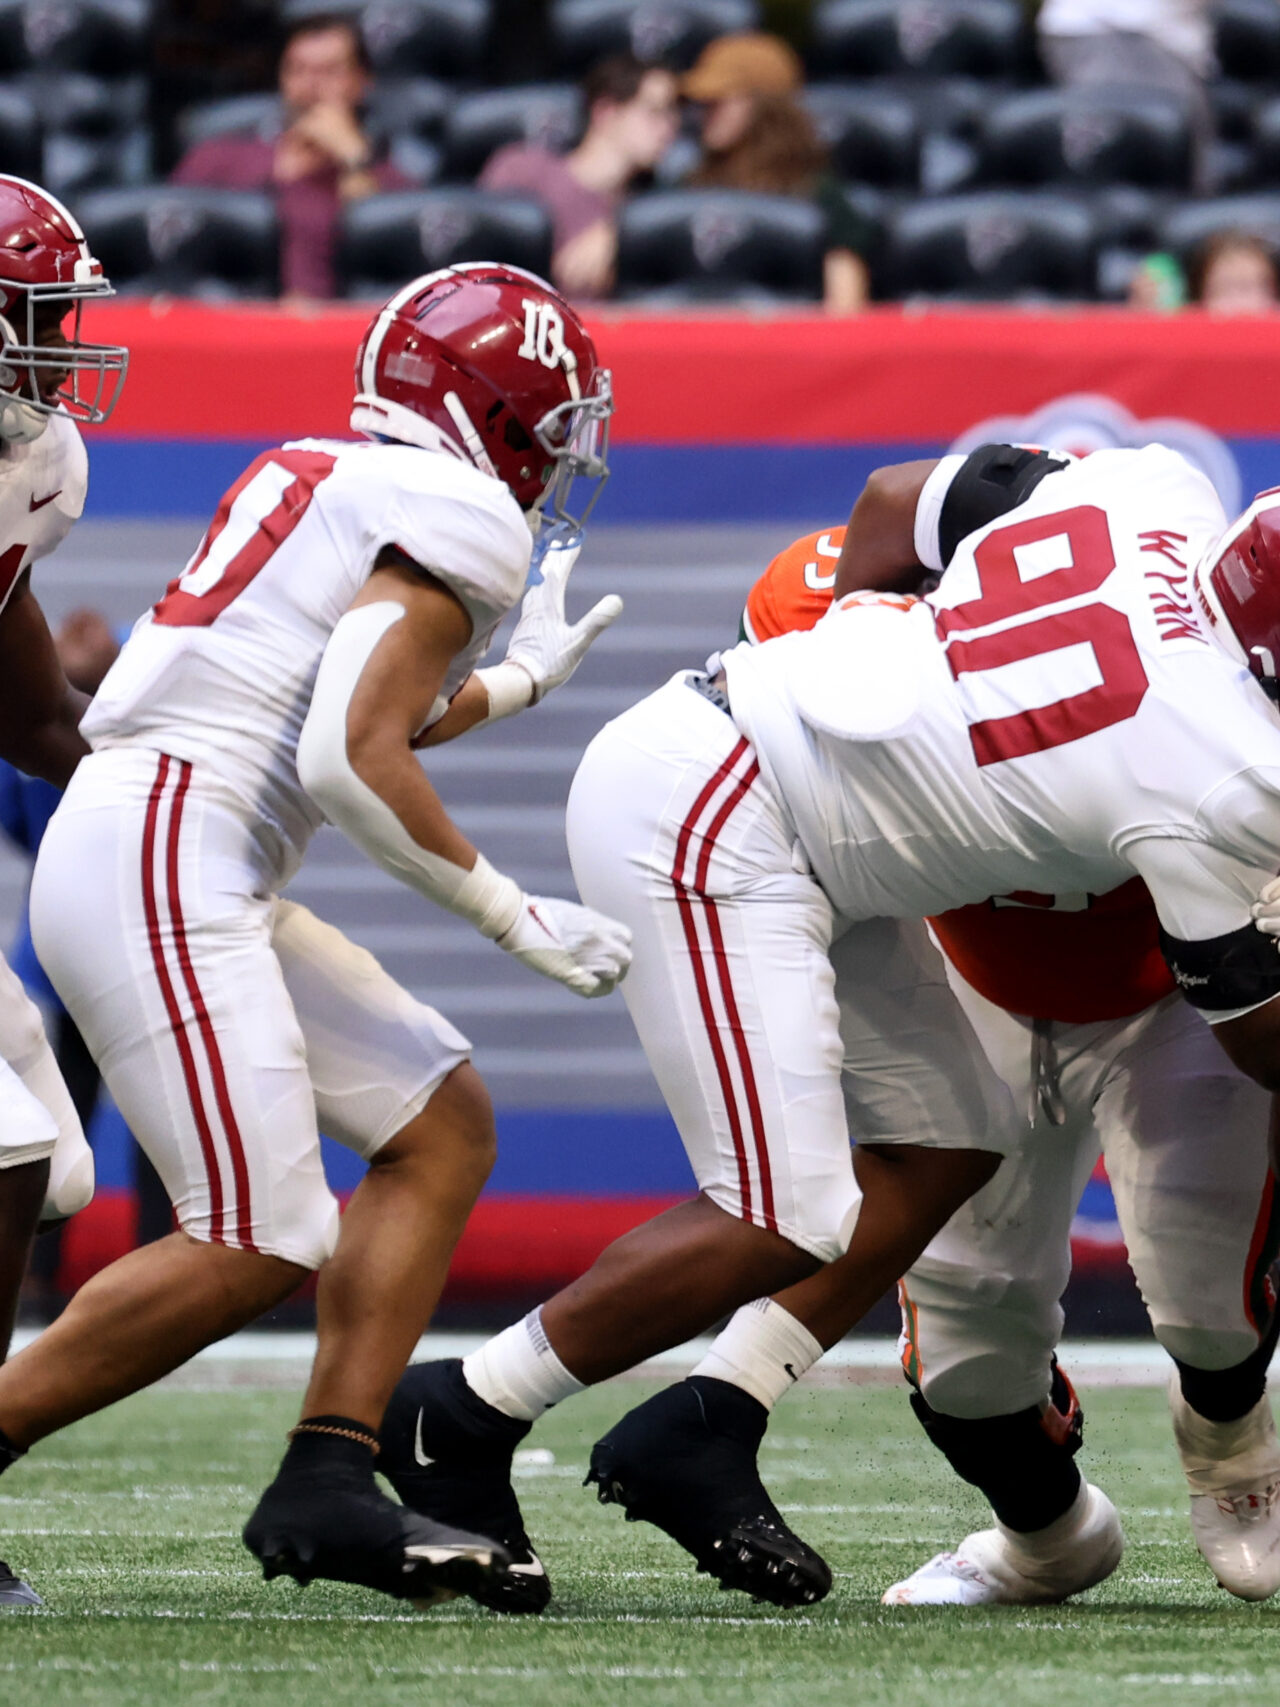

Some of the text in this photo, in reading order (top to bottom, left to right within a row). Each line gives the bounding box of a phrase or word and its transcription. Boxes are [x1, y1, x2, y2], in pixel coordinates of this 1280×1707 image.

[517, 297, 564, 370] 10
[934, 504, 1150, 768] 90
[1137, 529, 1210, 646] WYNN
